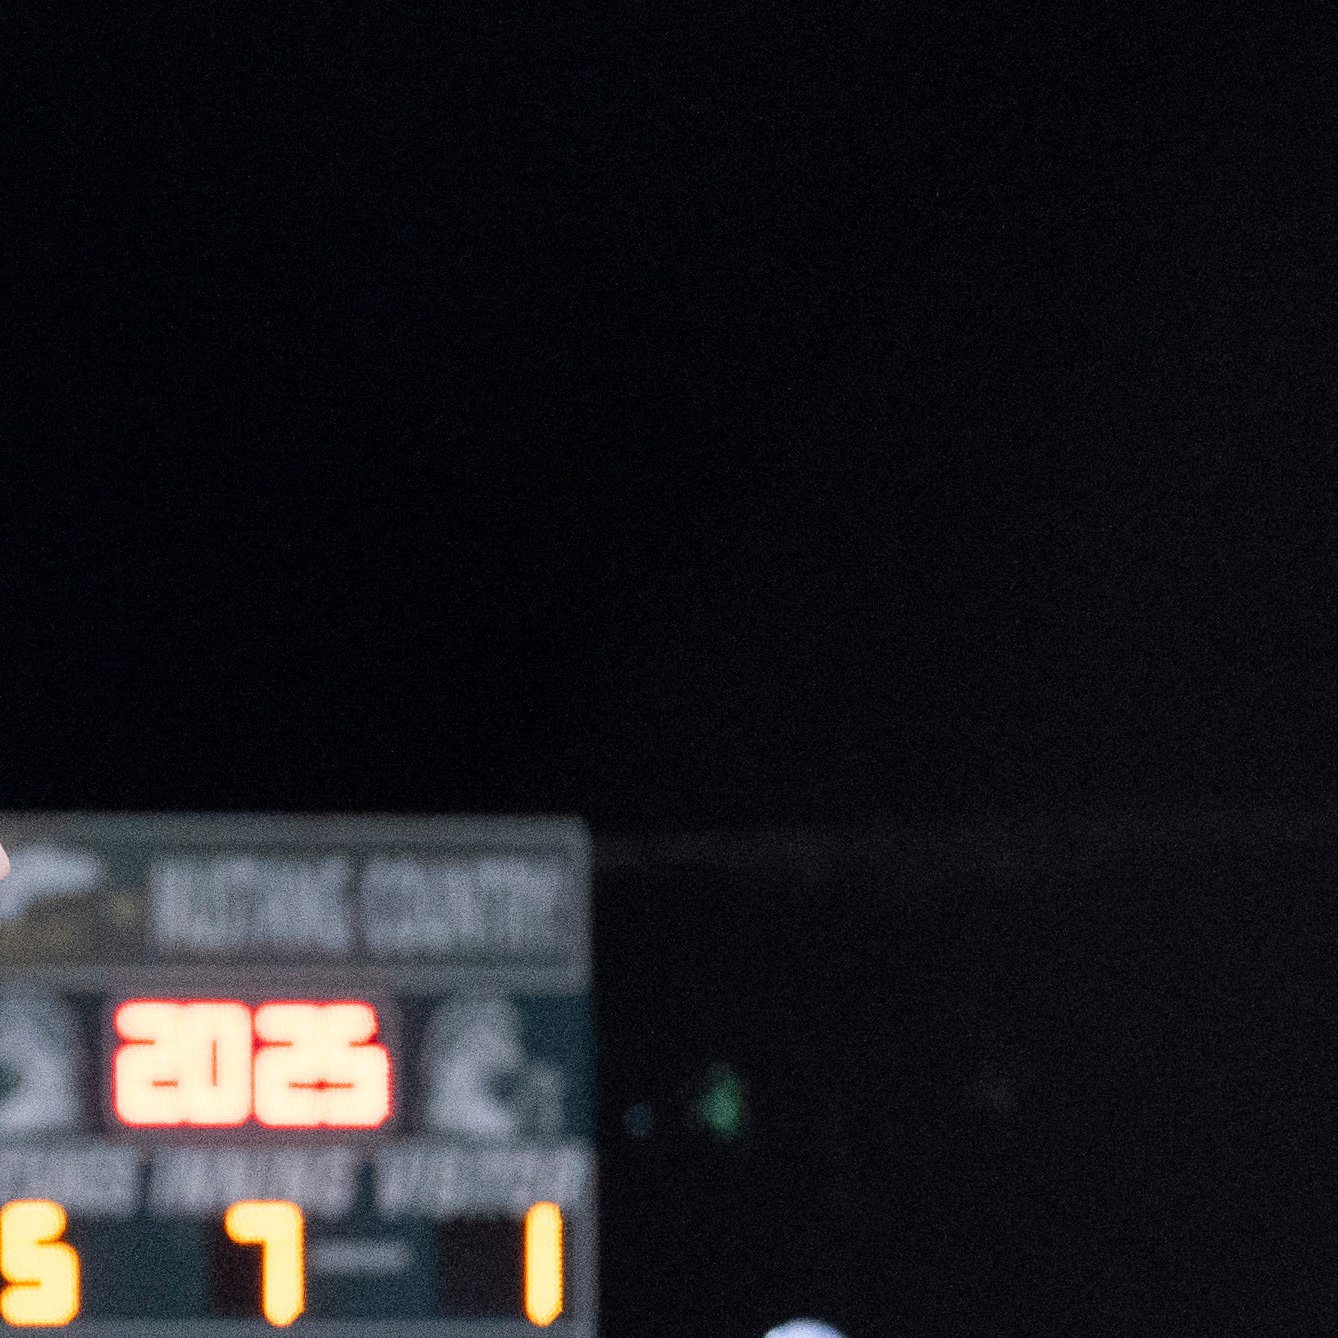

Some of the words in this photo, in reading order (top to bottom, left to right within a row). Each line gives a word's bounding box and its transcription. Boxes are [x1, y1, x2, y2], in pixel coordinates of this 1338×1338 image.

[114, 999, 392, 1128] 2025
[224, 1200, 306, 1328] 7
[524, 1201, 563, 1328] 1
